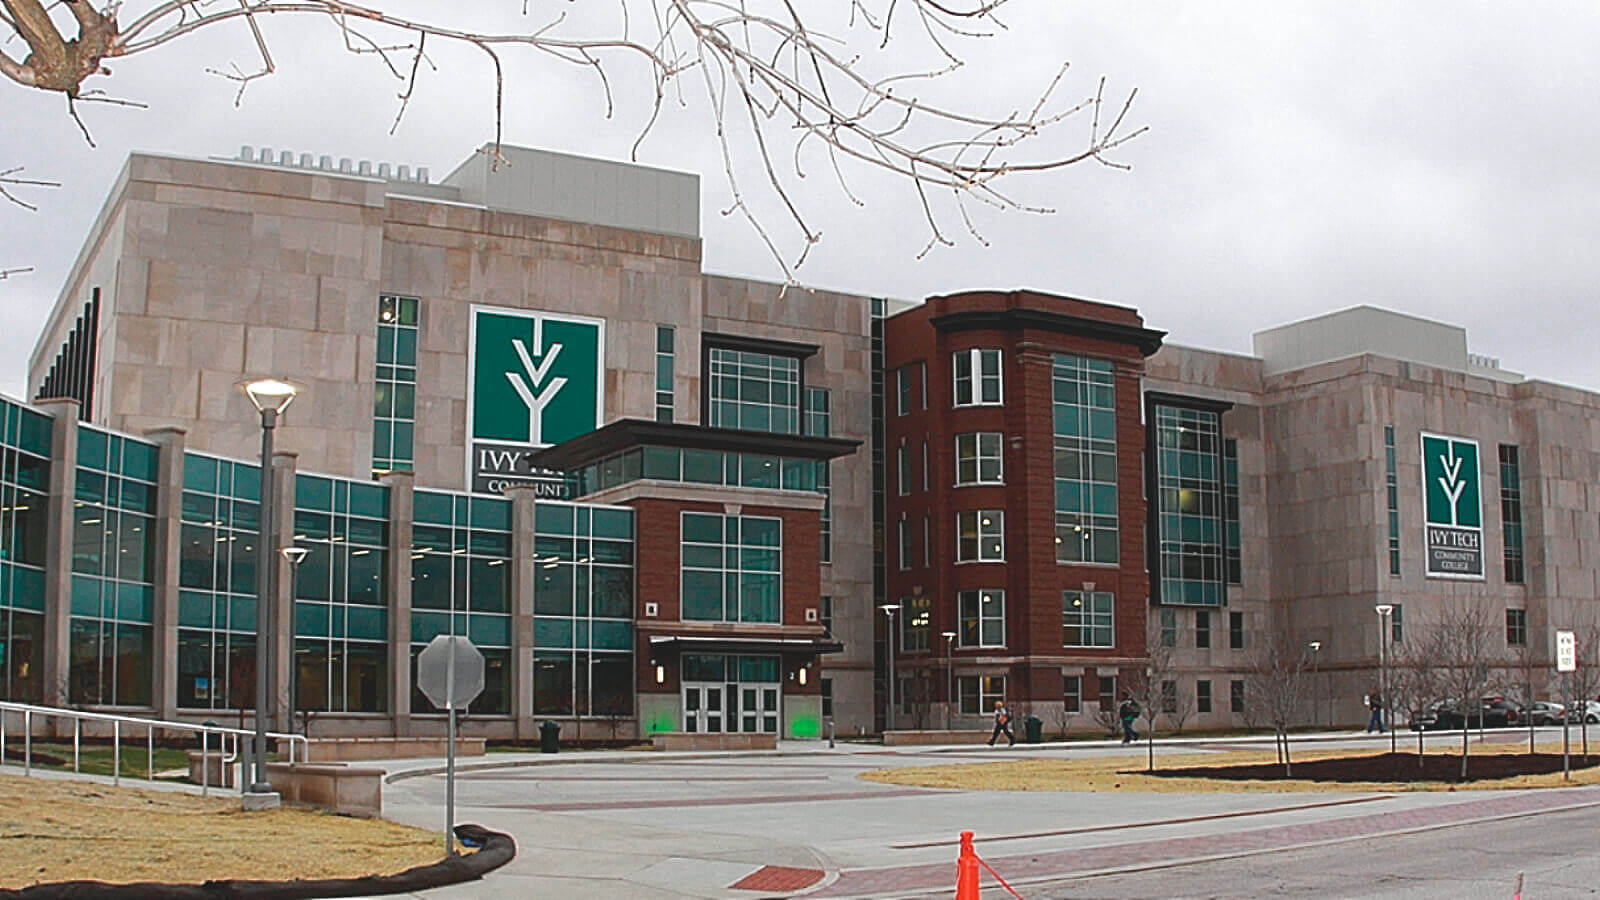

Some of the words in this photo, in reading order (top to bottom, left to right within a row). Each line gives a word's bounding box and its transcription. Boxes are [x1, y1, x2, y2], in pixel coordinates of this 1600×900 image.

[480, 449, 520, 471] IVY
[1430, 529, 1448, 545] IVY
[1451, 531, 1478, 547] TECH
